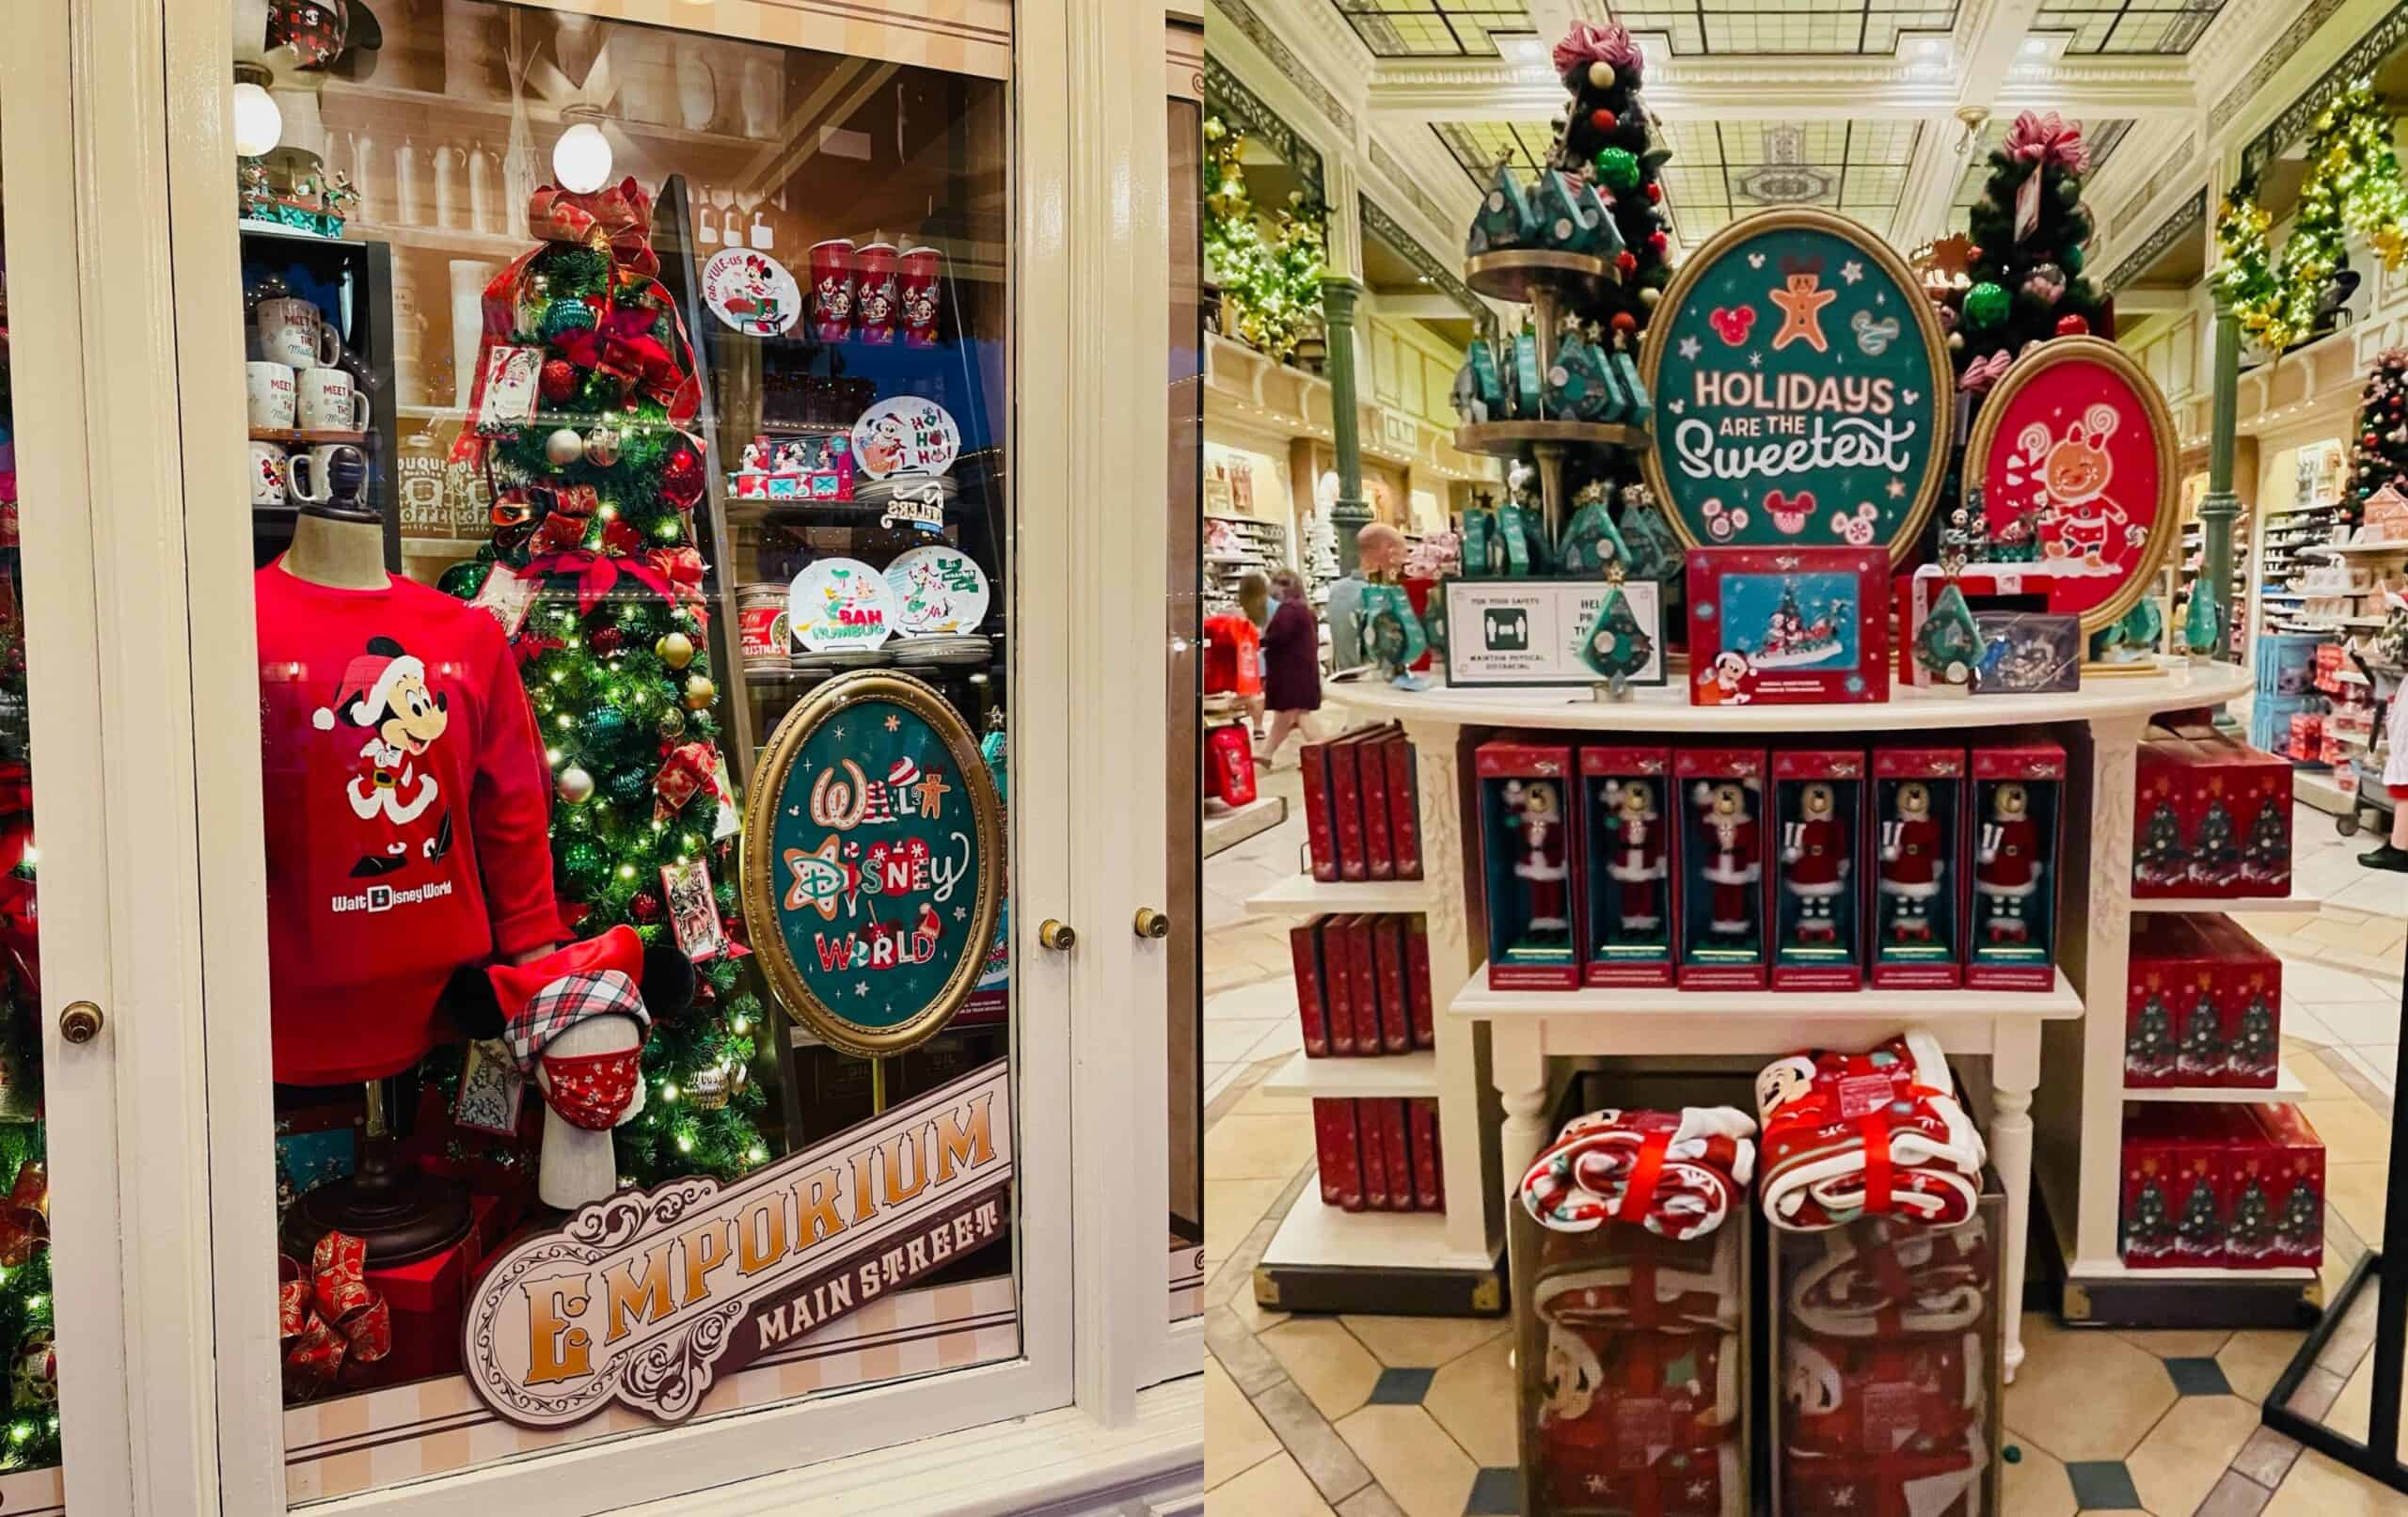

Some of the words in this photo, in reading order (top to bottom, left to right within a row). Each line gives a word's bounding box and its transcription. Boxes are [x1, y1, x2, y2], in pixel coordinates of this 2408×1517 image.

[271, 379, 292, 391] MEET
[323, 385, 346, 396] MEET
[1694, 370, 1895, 415] HOLIDAYS
[1719, 417, 1762, 436] ARE
[1766, 415, 1807, 435] THE
[1674, 416, 1917, 480] Sweetest
[838, 609, 882, 625] BAH
[1580, 599, 1601, 609] HEL
[812, 623, 886, 640] HUMBUG
[810, 758, 951, 831] WALT
[331, 895, 367, 912] Walt
[367, 884, 422, 913] Disney
[422, 880, 452, 899] World
[814, 929, 937, 972] WORLD
[523, 1089, 999, 1387] EMPORIUM
[756, 1273, 853, 1351] MAIN
[859, 1199, 999, 1300] STREET
